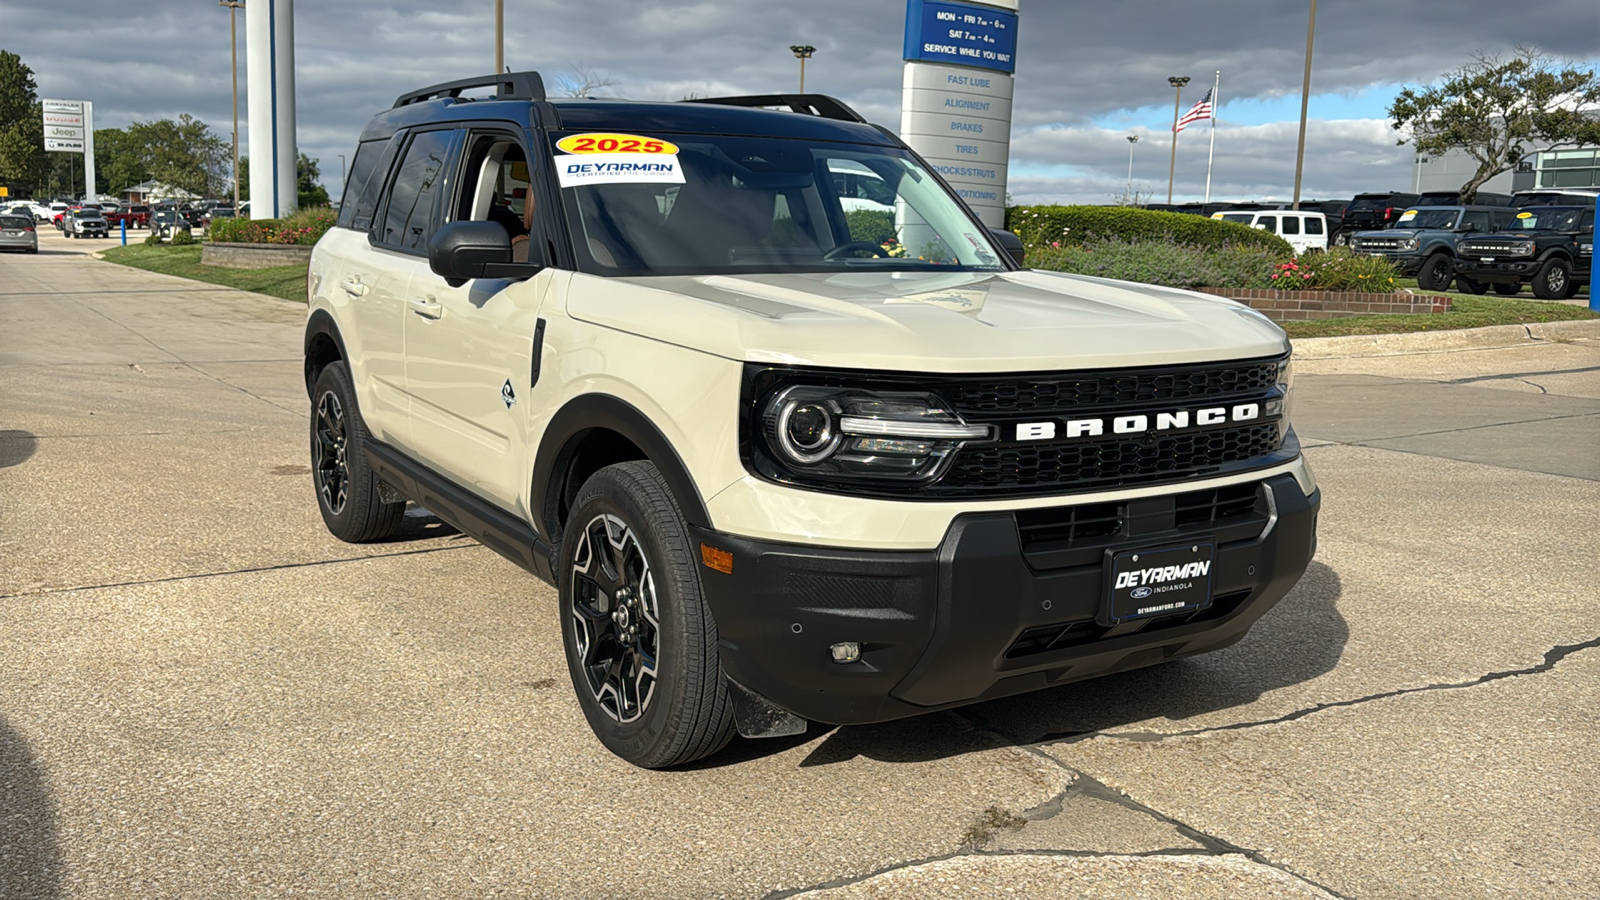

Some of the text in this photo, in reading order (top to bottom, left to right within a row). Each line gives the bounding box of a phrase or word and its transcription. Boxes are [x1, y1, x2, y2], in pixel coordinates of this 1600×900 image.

[937, 11, 956, 21] MON
[964, 15, 975, 24] FRI
[948, 29, 963, 39] SAT
[924, 43, 1010, 62] SERVICE WHILE YOU WAIT
[947, 74, 991, 89] FAST LUBE
[944, 98, 991, 111] ALIGNMENT
[52, 128, 76, 137] Jeep
[950, 121, 983, 133] BRAKES
[572, 138, 665, 153] 2025
[955, 144, 978, 155] TIRES
[567, 163, 673, 174] DEYARMAN
[1016, 403, 1259, 441] BRONCO
[1114, 560, 1211, 589] DEYARMAN
[1153, 582, 1193, 594] INDIANOLA
[1137, 601, 1186, 615] DEYARMANFORD.COM
